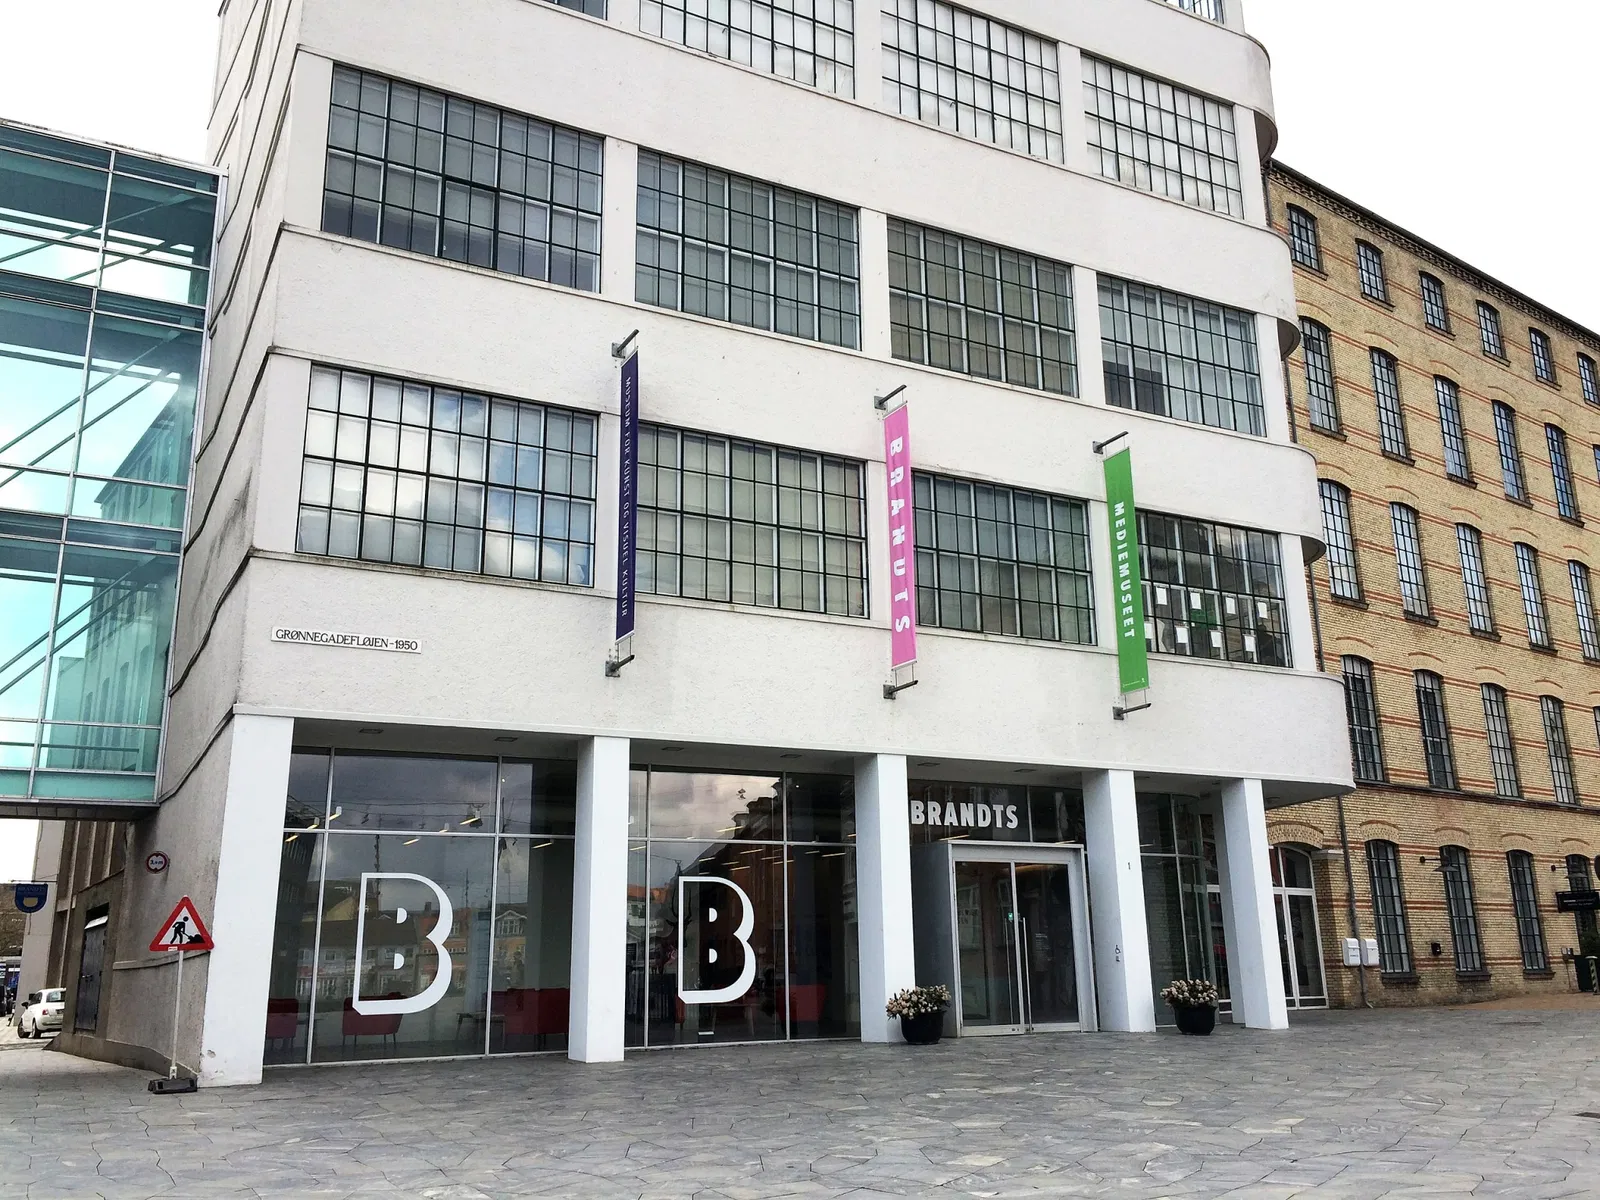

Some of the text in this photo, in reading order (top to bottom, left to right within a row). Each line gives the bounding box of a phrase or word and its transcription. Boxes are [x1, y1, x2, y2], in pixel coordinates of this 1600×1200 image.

[622, 501, 630, 519] OG
[623, 458, 631, 497] KUNST
[890, 435, 910, 634] BRANDTS
[1113, 501, 1136, 638] MEDIEMUSEET
[621, 569, 629, 617] KULTUR
[910, 800, 1018, 829] BRANDTS
[352, 872, 453, 1016] B
[677, 875, 757, 1005] B
